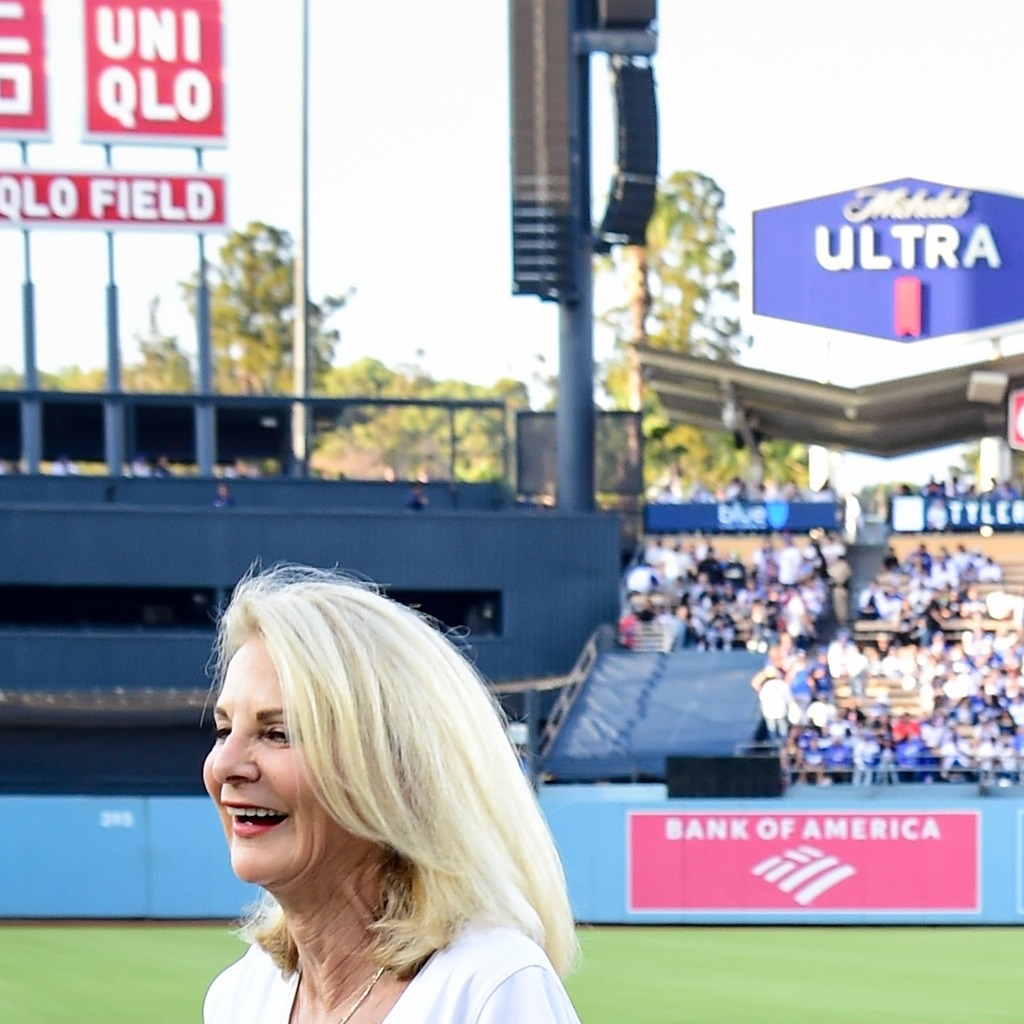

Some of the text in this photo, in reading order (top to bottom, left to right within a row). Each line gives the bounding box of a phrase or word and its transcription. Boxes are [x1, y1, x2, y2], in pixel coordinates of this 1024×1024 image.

[96, 6, 201, 63] UNI
[98, 65, 213, 129] QLO
[89, 178, 215, 221] FIELD
[814, 223, 1001, 271] ULTRA
[666, 816, 942, 841] BANK OF AMERICA
